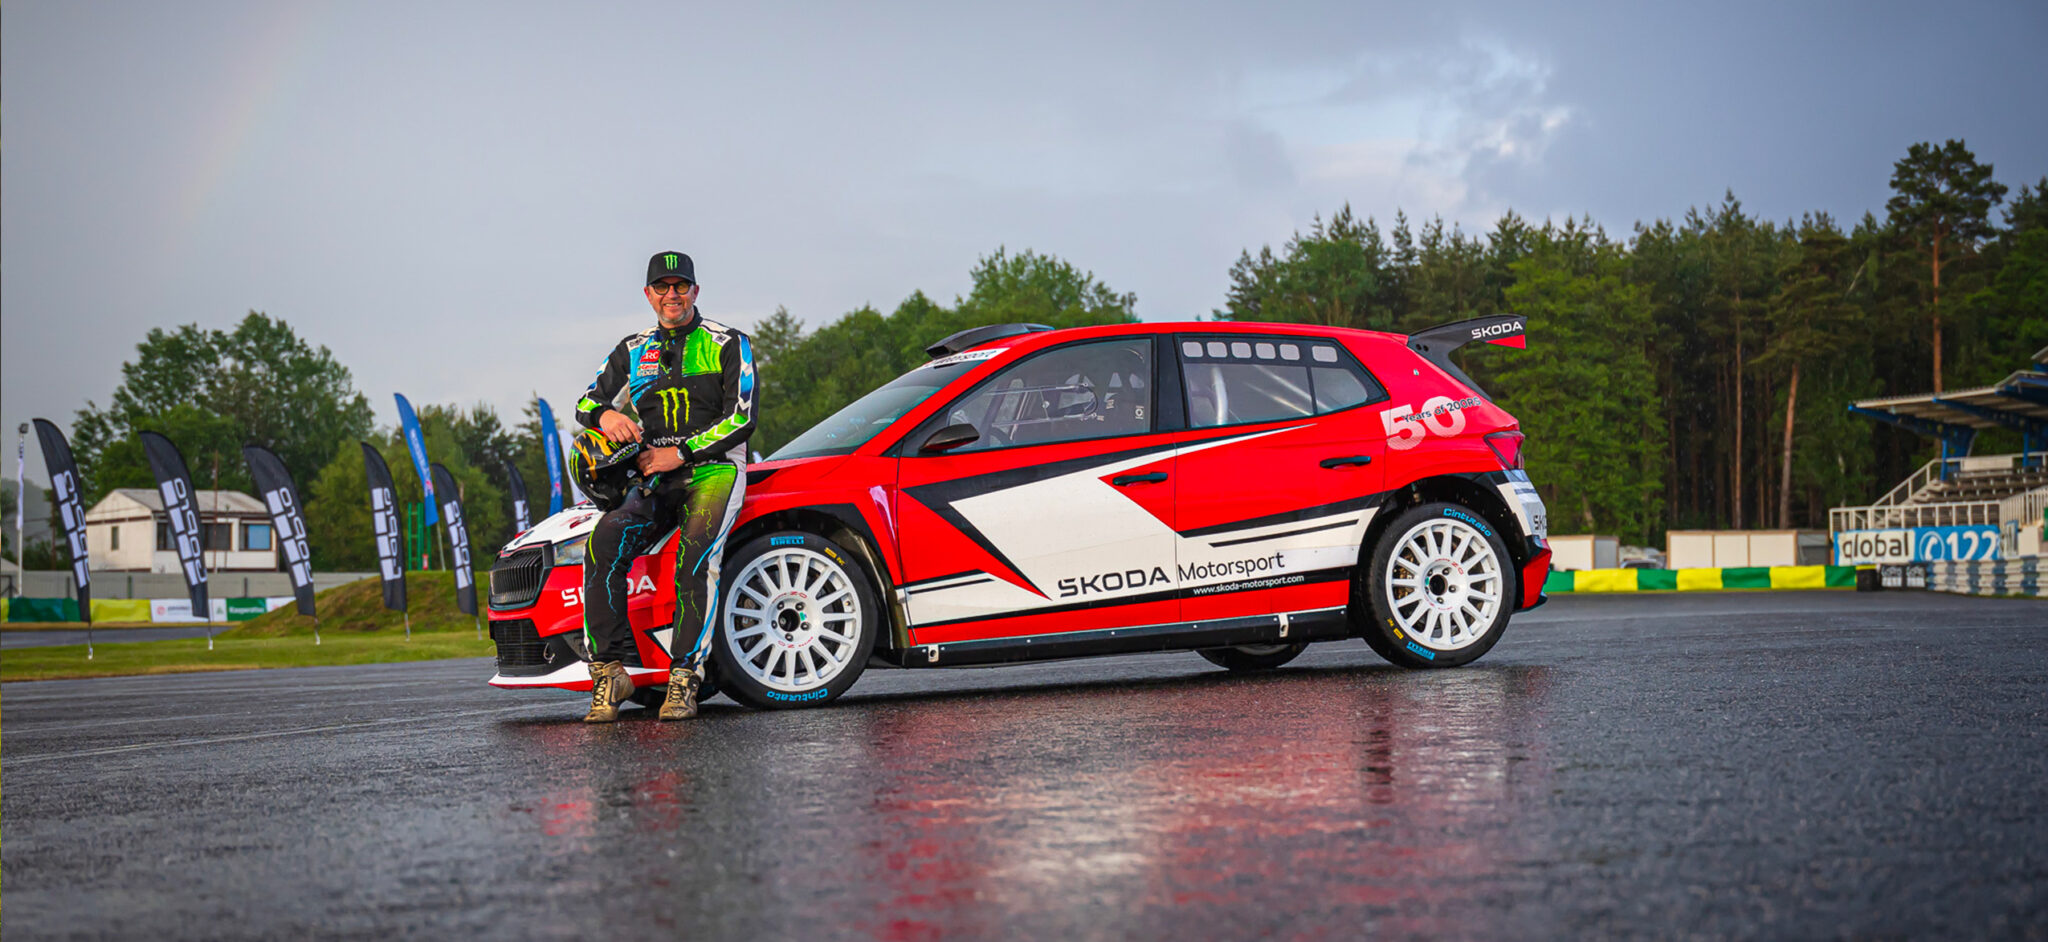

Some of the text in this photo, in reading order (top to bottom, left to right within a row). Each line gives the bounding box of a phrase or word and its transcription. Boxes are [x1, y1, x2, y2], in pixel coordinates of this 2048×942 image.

[1471, 321, 1523, 339] SKODA
[1380, 395, 1467, 451] 50
[1402, 410, 1432, 423] Years
[1434, 405, 1446, 416] of
[1058, 552, 1285, 598] SKODA Motorsport
[1193, 575, 1305, 595] www.skoda-motorsport.com
